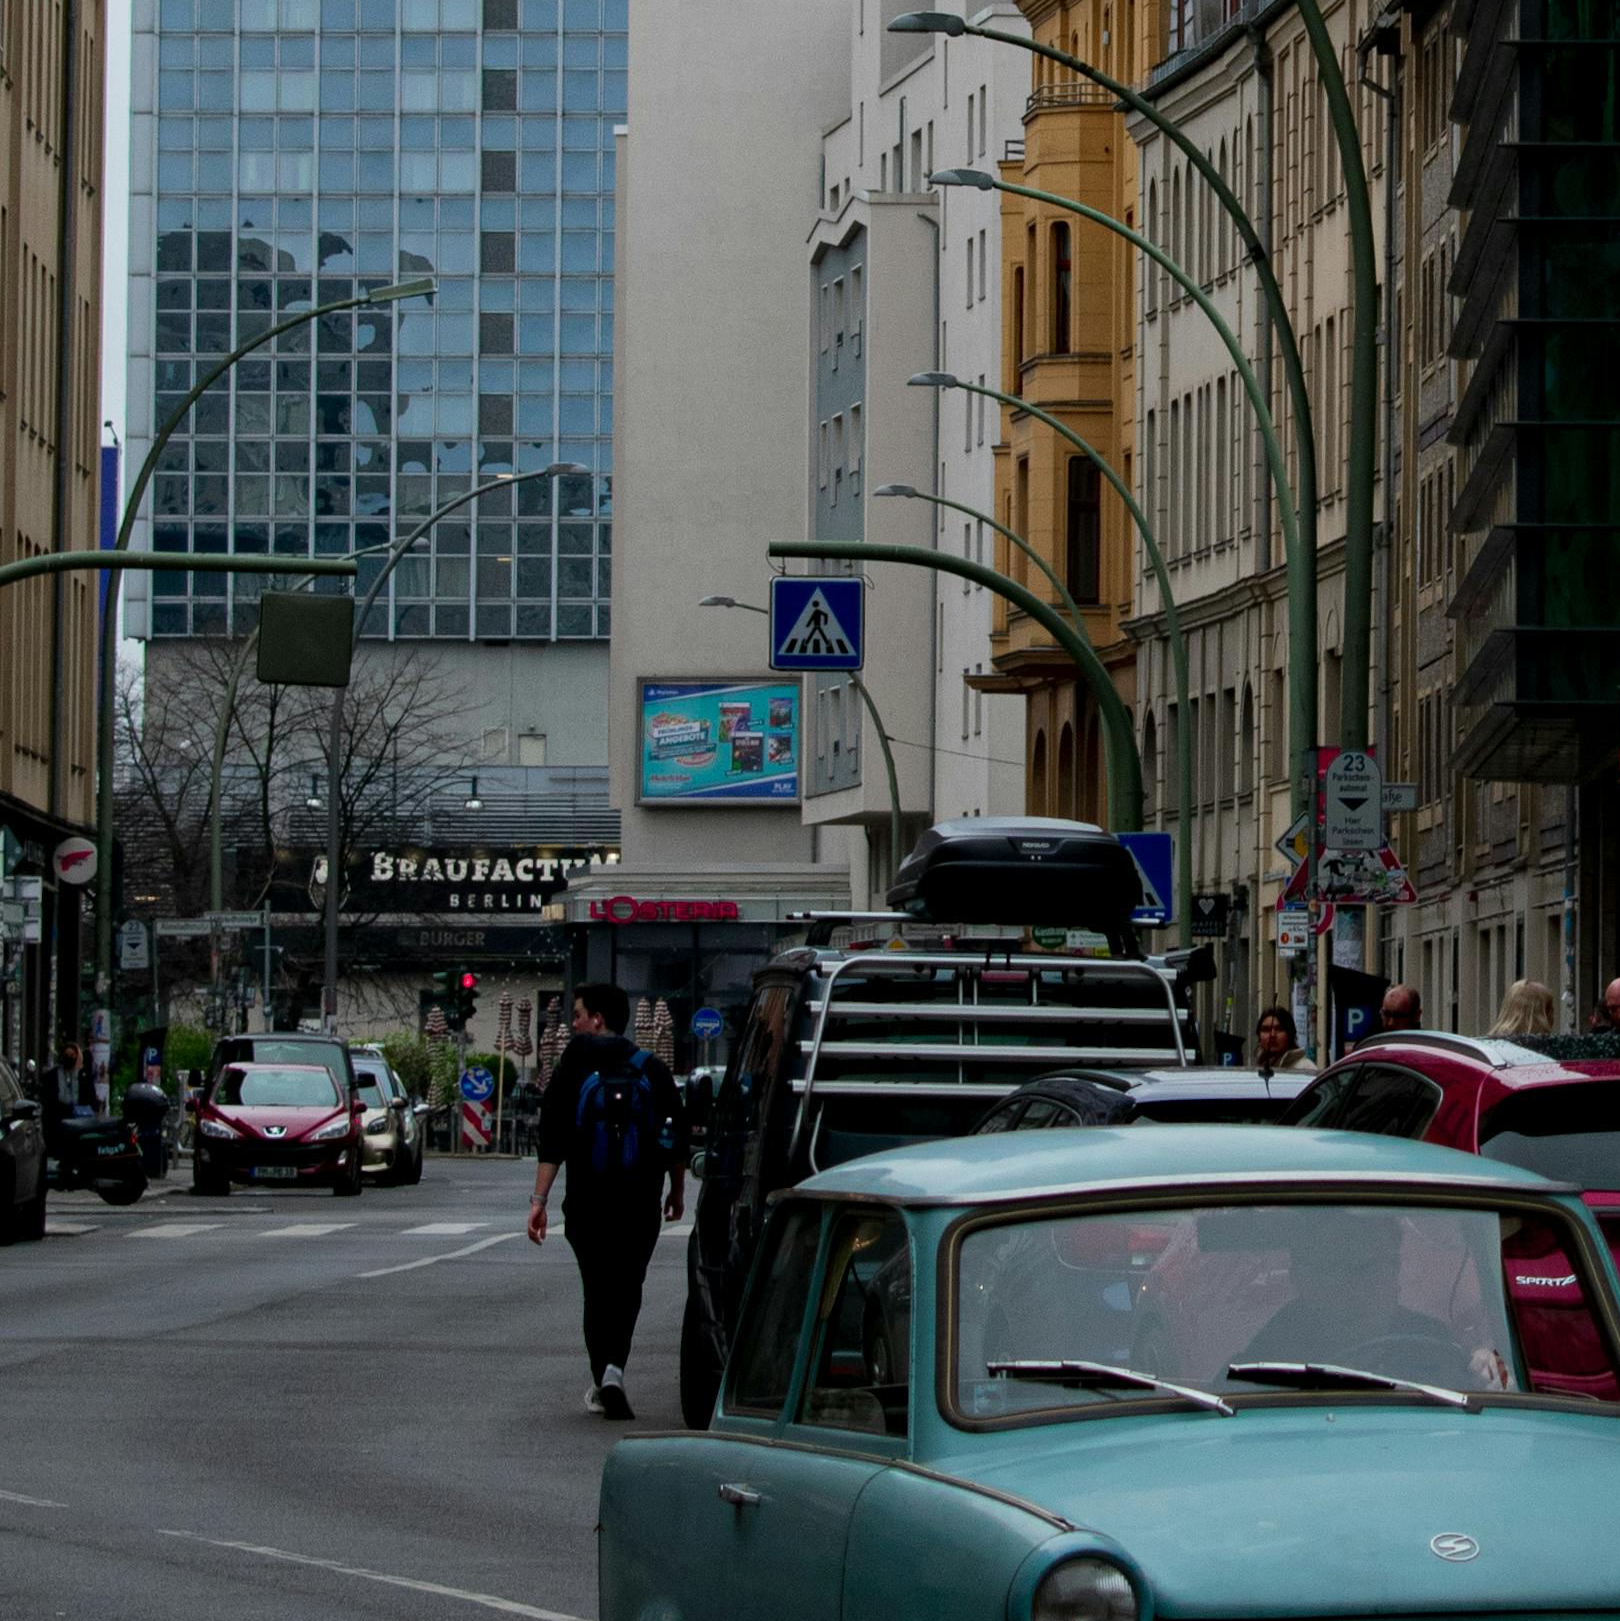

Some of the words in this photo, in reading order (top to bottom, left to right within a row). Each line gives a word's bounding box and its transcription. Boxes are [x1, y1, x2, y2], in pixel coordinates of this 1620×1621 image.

[1343, 754, 1366, 772] 23
[1339, 784, 1368, 792] automat
[449, 893, 543, 908] BERLIN
[419, 931, 486, 947] BURGER
[1347, 1007, 1365, 1033] P
[1223, 1053, 1233, 1066] P
